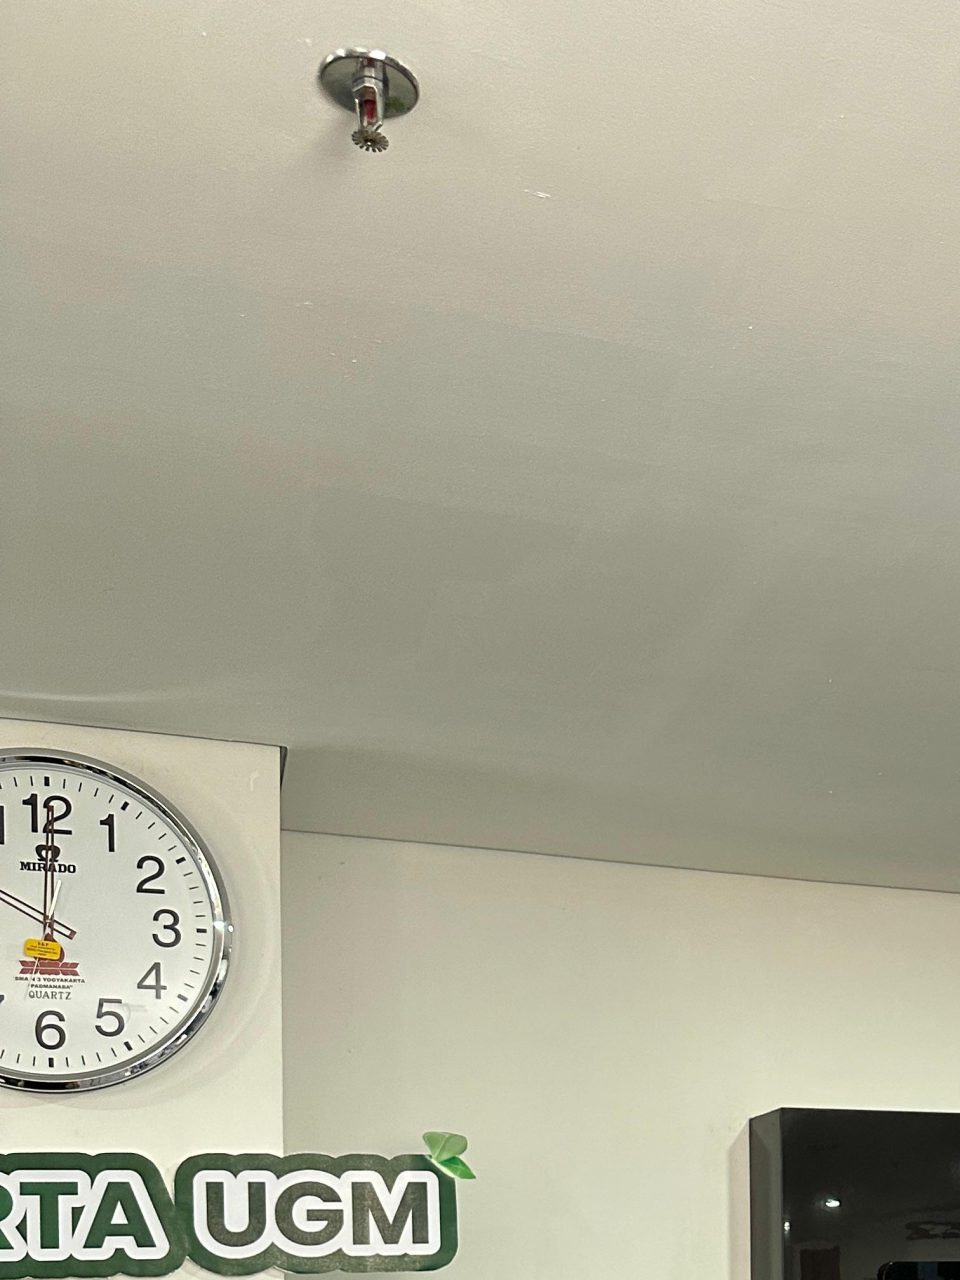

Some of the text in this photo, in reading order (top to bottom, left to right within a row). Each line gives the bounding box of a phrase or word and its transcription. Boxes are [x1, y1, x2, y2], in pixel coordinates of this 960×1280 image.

[22, 793, 73, 835] 12
[99, 813, 115, 852] 1
[20, 861, 77, 873] MIRADO
[136, 855, 166, 895] 2
[152, 909, 182, 948] 3
[28, 990, 72, 1001] QUARTZ
[136, 961, 168, 1000] 4
[34, 1010, 67, 1050] 6
[94, 998, 126, 1037] 5
[206, 1180, 430, 1247] UGM
